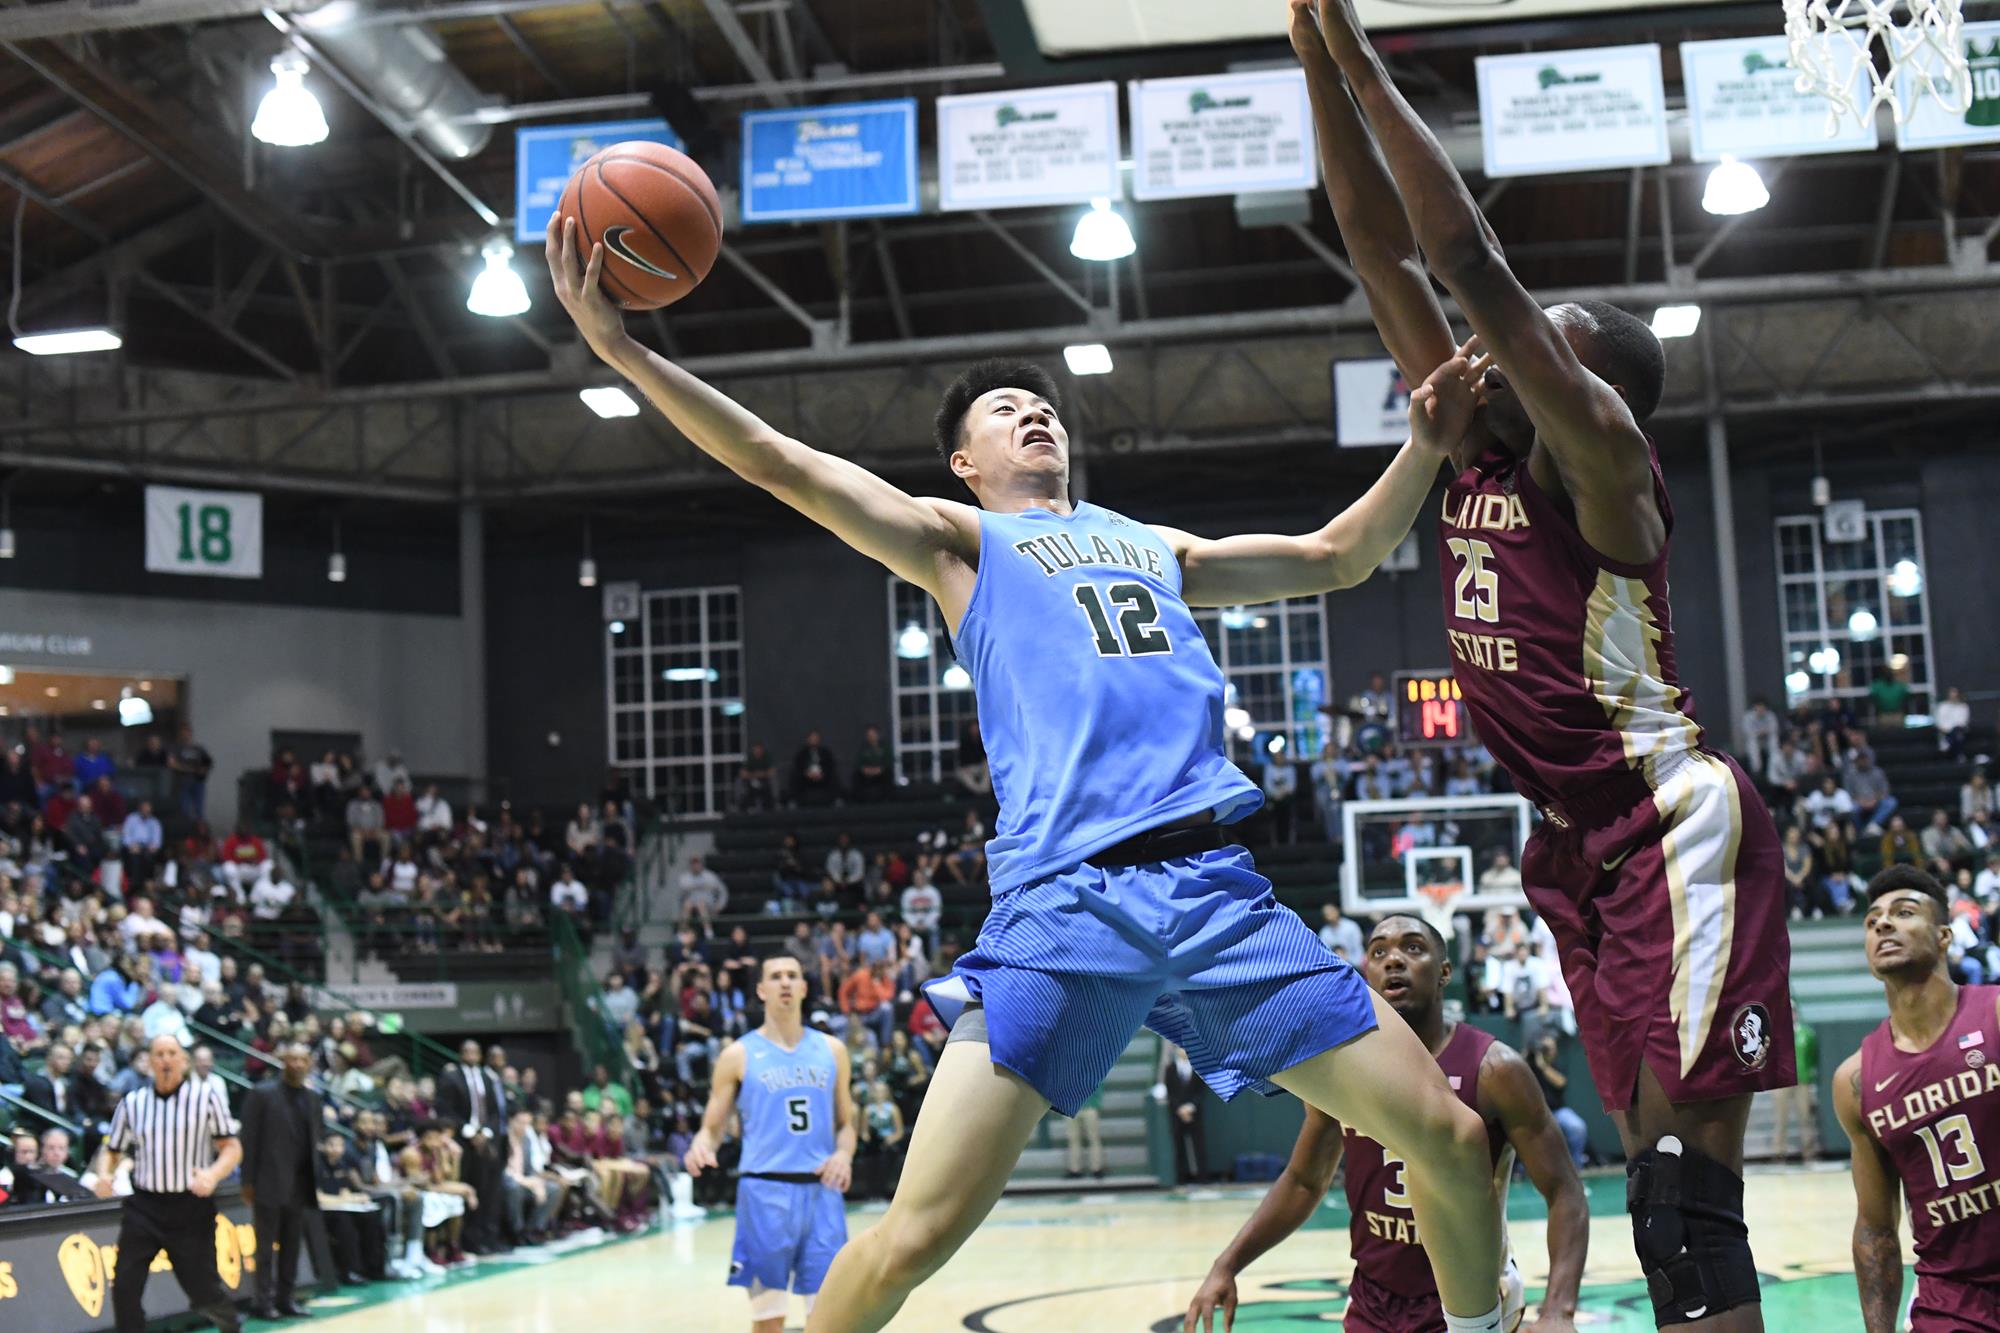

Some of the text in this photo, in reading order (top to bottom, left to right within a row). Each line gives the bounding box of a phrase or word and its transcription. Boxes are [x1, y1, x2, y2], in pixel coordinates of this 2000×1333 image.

[1974, 69, 2000, 100] 10
[176, 501, 232, 563] 18
[1012, 532, 1164, 580] TULANE
[1446, 537, 1499, 623] 25
[1072, 582, 1173, 658] 12
[1448, 628, 1519, 672] STATE
[1422, 700, 1457, 738] 14
[760, 1066, 829, 1095] TULANE
[1867, 1063, 2000, 1138] FLORIDA
[784, 1095, 813, 1135] 5
[1913, 1113, 1985, 1189] 13
[1383, 1149, 1412, 1208] 3
[1364, 1210, 1423, 1245] STAT
